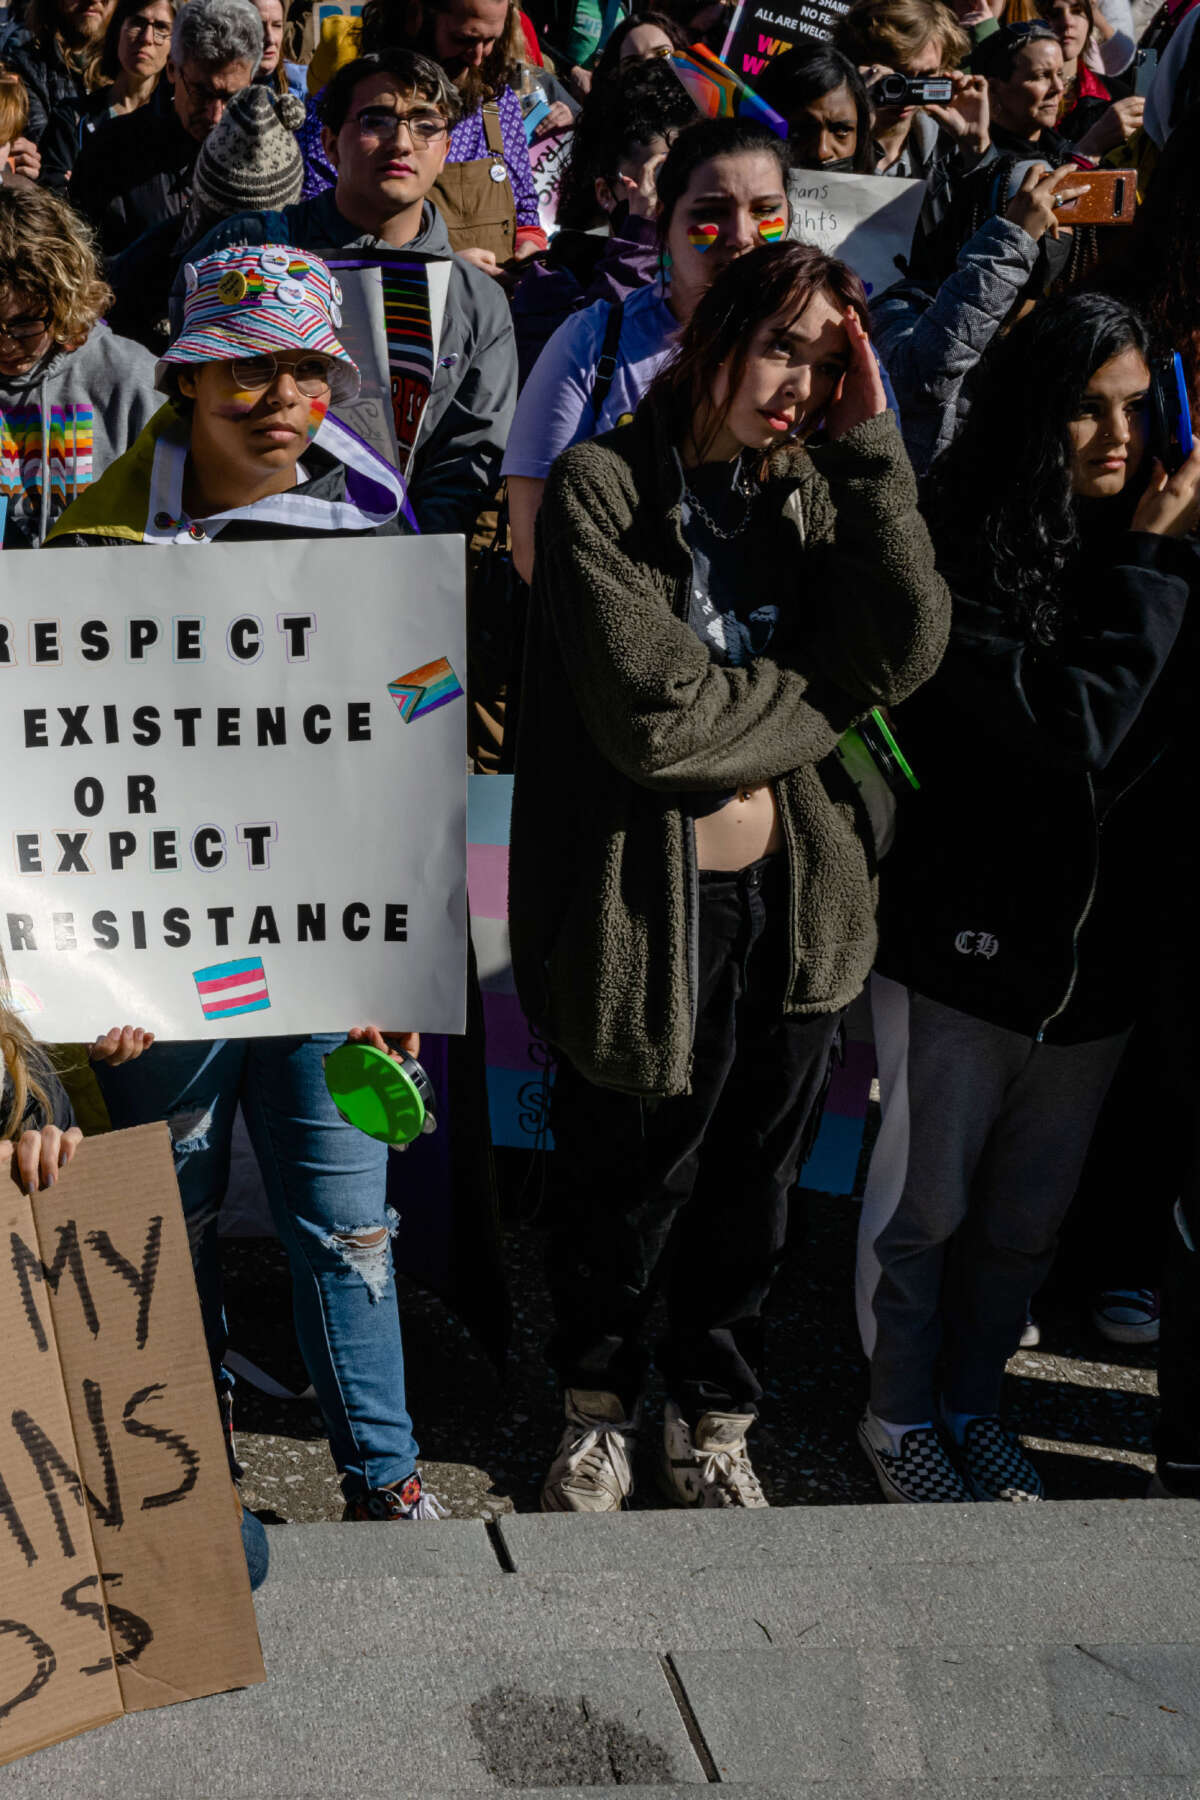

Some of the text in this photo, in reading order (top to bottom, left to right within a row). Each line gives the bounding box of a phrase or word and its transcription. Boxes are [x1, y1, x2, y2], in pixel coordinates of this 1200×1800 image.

[754, 8, 775, 22] ALL
[775, 15, 799, 30] ARE
[801, 5, 818, 19] NO
[23, 702, 372, 749] EXISTENCE
[74, 775, 157, 817] OR
[15, 825, 274, 874] EXPECT
[6, 903, 409, 952] RESISTANCE
[10, 1215, 163, 1353] MY
